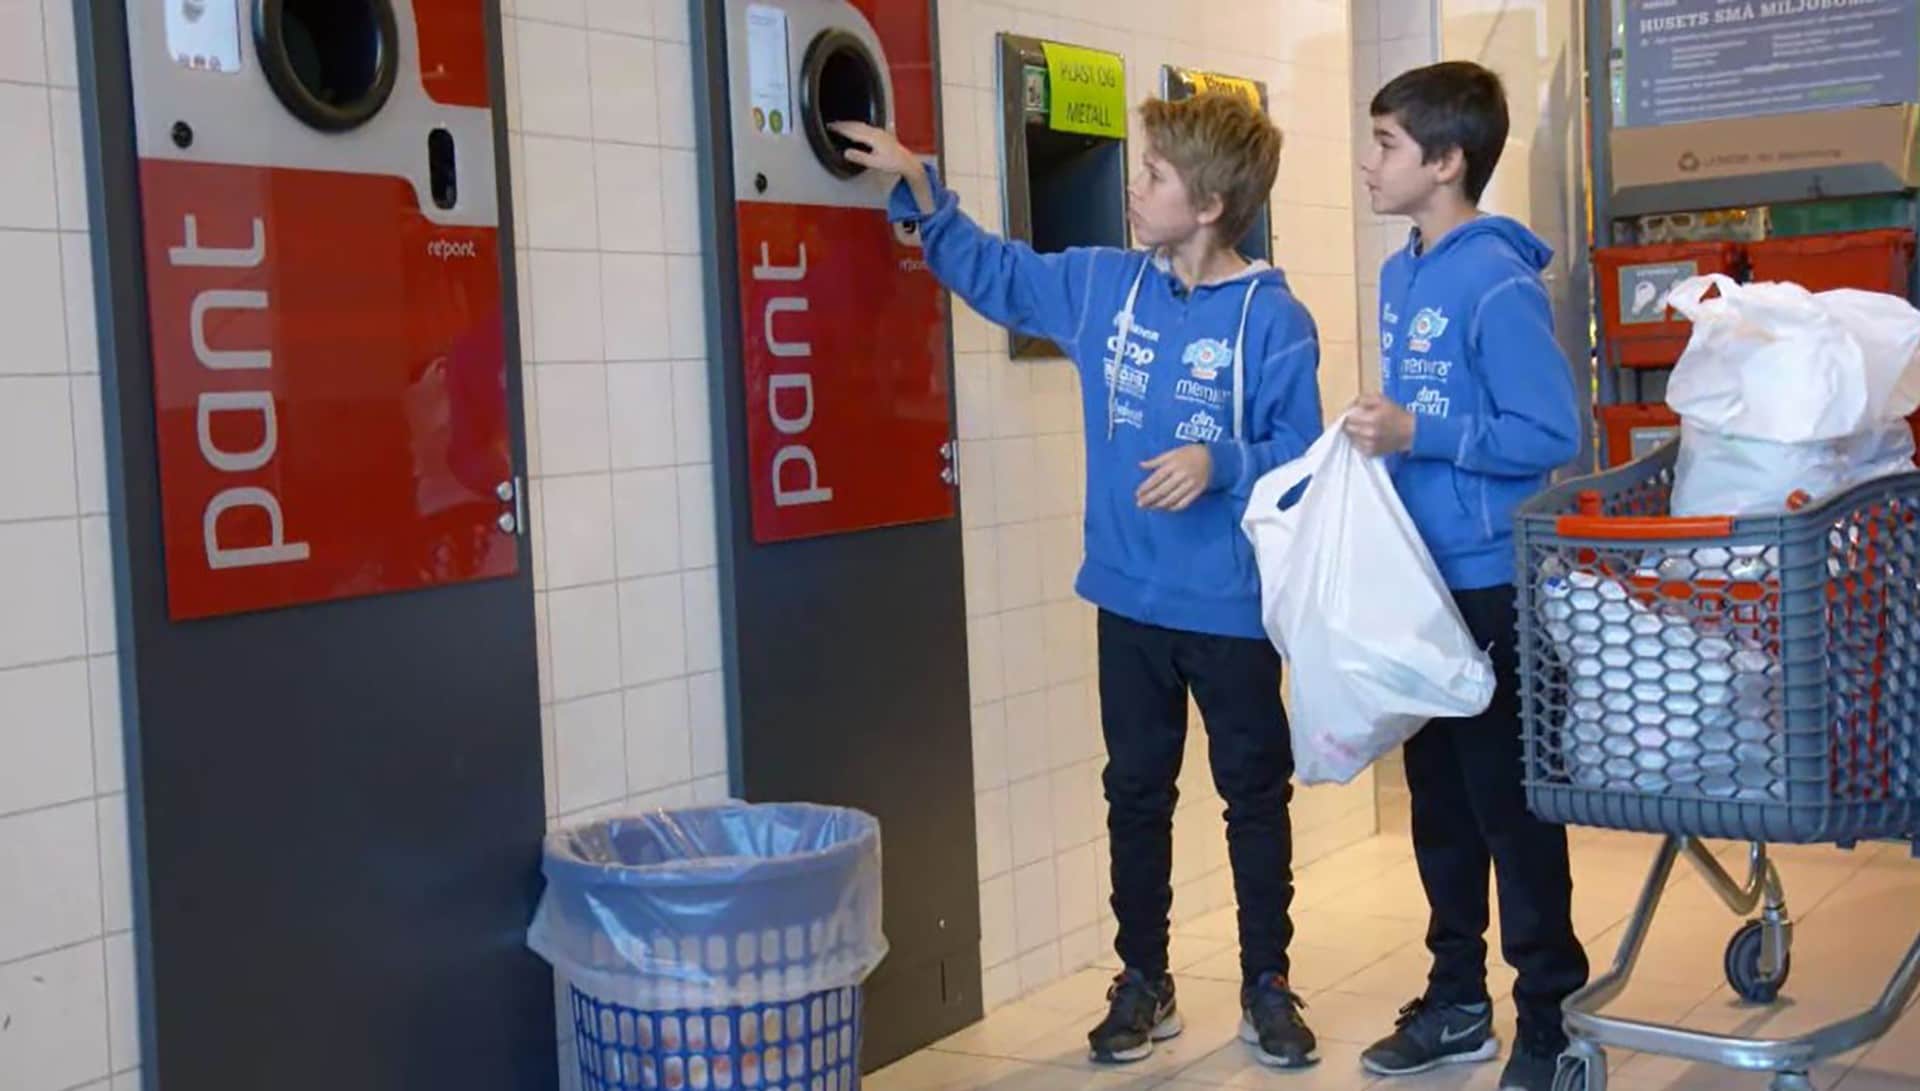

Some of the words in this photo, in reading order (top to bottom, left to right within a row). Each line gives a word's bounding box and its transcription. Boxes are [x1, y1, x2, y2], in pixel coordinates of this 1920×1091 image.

[1640, 11, 1709, 33] HUSETS
[1715, 3, 1754, 23] SMÅ
[1066, 102, 1111, 127] METALL
[168, 213, 310, 570] pant
[752, 241, 833, 507] pant
